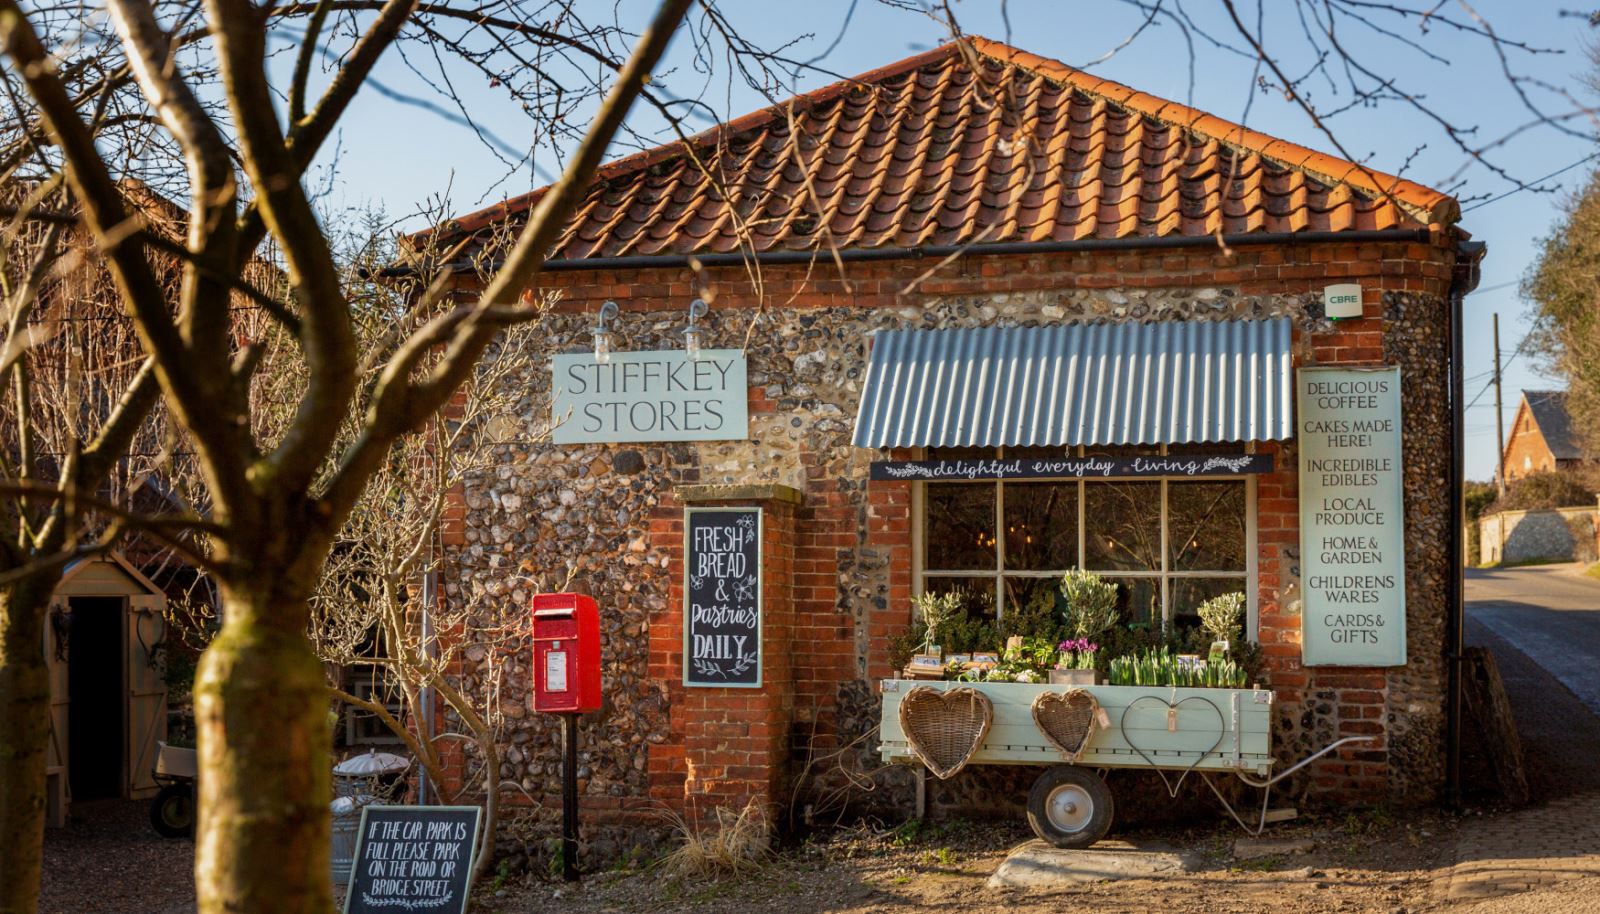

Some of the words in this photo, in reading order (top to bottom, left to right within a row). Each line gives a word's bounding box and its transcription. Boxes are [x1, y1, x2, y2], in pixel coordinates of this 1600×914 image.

[1329, 295, 1359, 304] CBRE
[568, 359, 734, 395] STIFFKEY
[1307, 381, 1389, 395] DELICIOUS
[1318, 396, 1378, 409] COFFEE
[583, 399, 724, 433] STORES
[1304, 420, 1350, 433] CAKES
[1352, 419, 1394, 433] MADE
[1327, 434, 1373, 448] HERE!
[933, 459, 1022, 479] delightful
[1031, 457, 1115, 477] everyday
[1307, 458, 1392, 472] INCREDIBLE
[1322, 473, 1378, 487] EDIBLES
[1323, 498, 1376, 511] LOCAL
[1315, 512, 1385, 526] PRODUCE
[694, 526, 743, 552] FRESH
[1322, 536, 1367, 550] HOME
[1368, 536, 1379, 550] &
[1320, 551, 1382, 564] GARDEN
[698, 552, 746, 579] BREAD
[1309, 575, 1395, 589] CHILDRENS
[715, 578, 730, 602] &
[1325, 590, 1380, 604] WARES
[1330, 629, 1379, 644] GIFTS
[693, 634, 747, 659] DAILY
[368, 821, 380, 839] IF
[382, 821, 403, 840] THE
[402, 821, 423, 840] CAR
[425, 821, 454, 840] PARK
[454, 821, 467, 840] IS
[365, 841, 390, 860] FULL
[391, 841, 431, 860] PLEASE
[432, 842, 461, 860] PARK
[368, 860, 387, 877] ON
[389, 860, 409, 877] THE
[410, 860, 436, 878] ROAD
[440, 860, 456, 878] OR
[371, 879, 409, 896] BRIDGE
[410, 879, 450, 897] STREET
